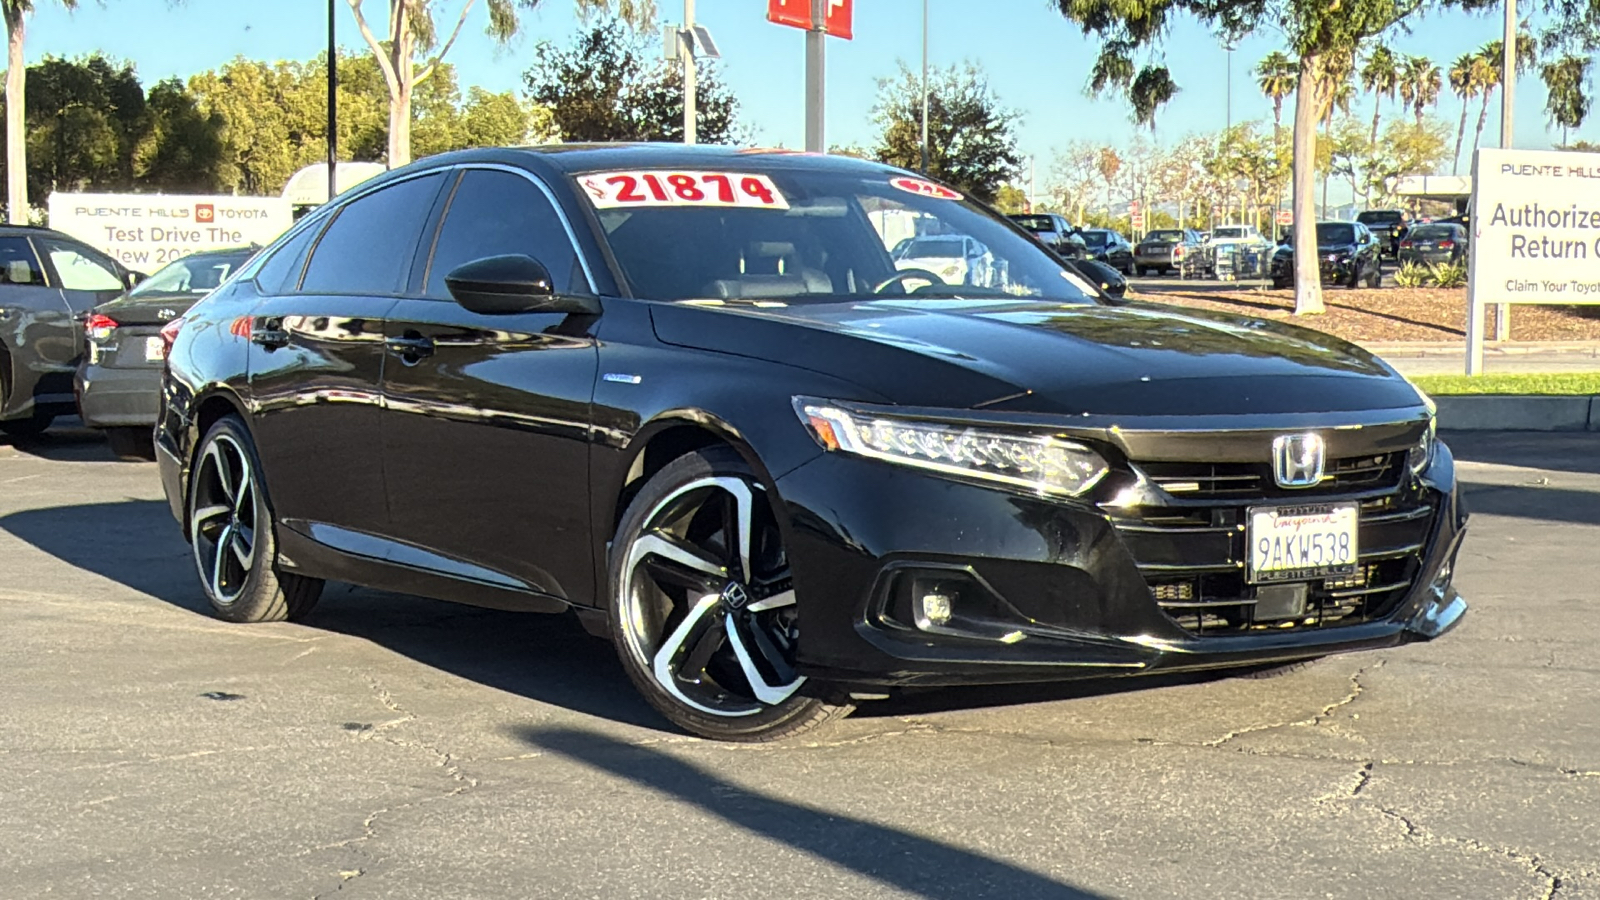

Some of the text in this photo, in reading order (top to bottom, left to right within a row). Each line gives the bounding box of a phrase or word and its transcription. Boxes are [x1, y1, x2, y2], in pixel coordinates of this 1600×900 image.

[1501, 164, 1563, 177] PUENTE
[75, 207, 268, 219] PUENTE HILLS TOYOTA
[105, 226, 242, 243] Test Drive The
[1511, 234, 1587, 259] Return
[1506, 279, 1538, 292] Claim
[1542, 280, 1567, 292] Your
[1258, 532, 1349, 570] 9AKW538
